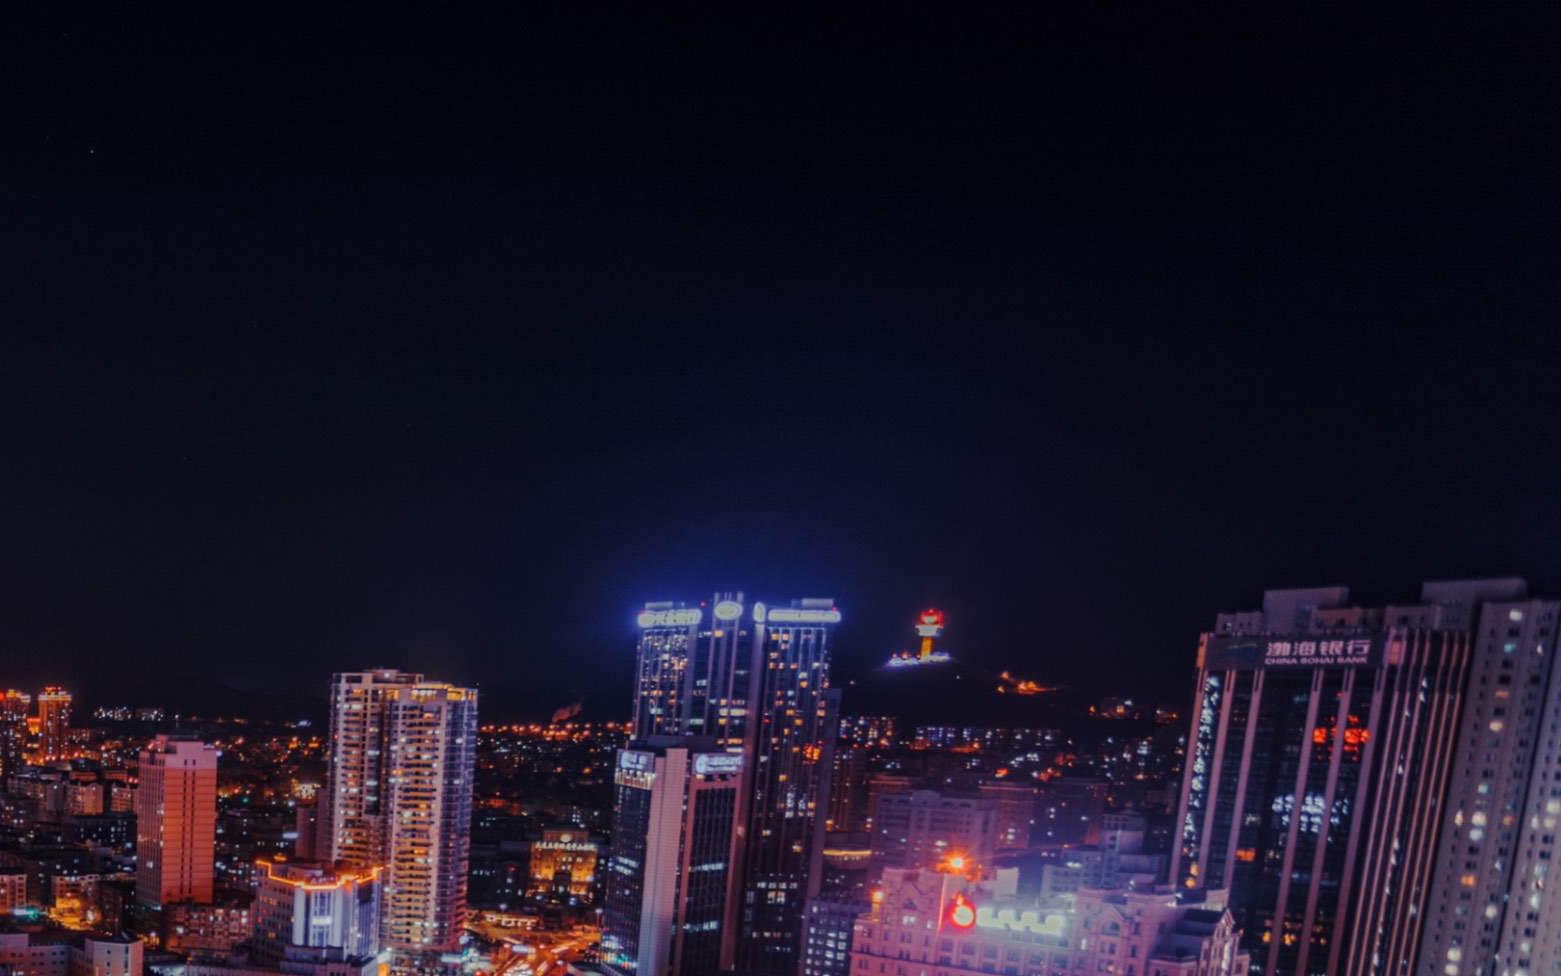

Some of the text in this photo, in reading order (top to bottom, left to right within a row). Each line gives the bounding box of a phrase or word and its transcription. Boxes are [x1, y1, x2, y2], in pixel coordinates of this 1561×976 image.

[1266, 640, 1371, 656] 渤海银行
[1264, 656, 1368, 665] CHINA BOHAI BANK
